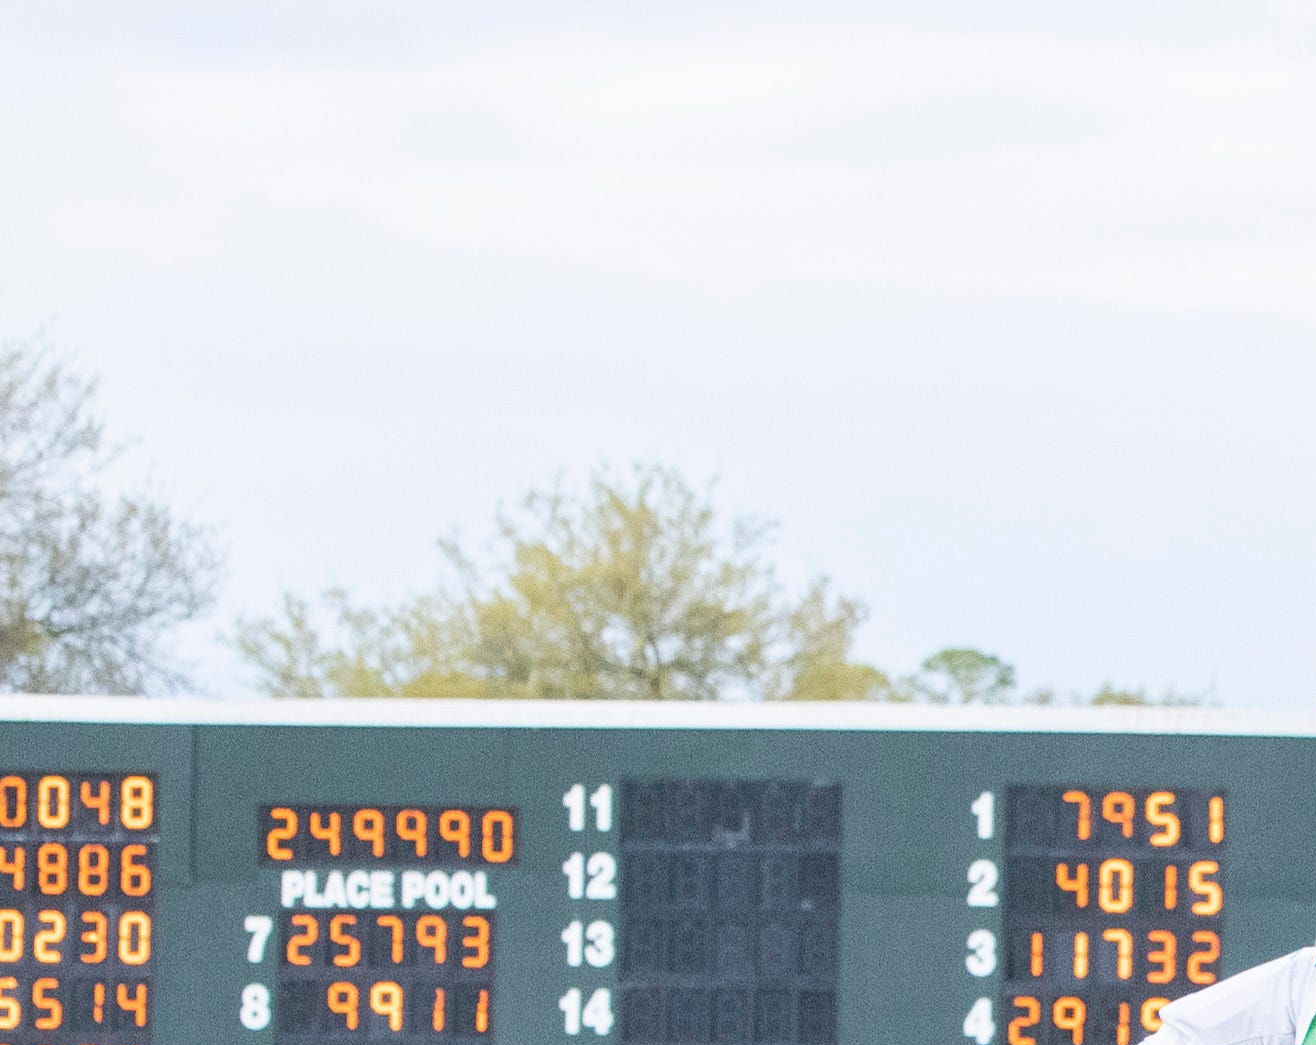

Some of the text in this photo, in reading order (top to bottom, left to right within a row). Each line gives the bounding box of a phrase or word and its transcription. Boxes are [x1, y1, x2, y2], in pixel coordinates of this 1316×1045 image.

[562, 784, 613, 832] 11
[970, 791, 995, 839] 1
[1062, 790, 1225, 847] 7951
[266, 807, 514, 863] 249990
[280, 870, 497, 910] PLACE POOL
[562, 852, 617, 900] 12
[966, 859, 999, 907] 2
[244, 916, 272, 964] 7
[286, 915, 490, 968] 25793
[561, 920, 615, 967] 13
[965, 929, 997, 977] 3
[240, 983, 270, 1030] 8
[327, 981, 490, 1032] 9911
[559, 987, 614, 1036] 14
[963, 997, 994, 1045] 4
